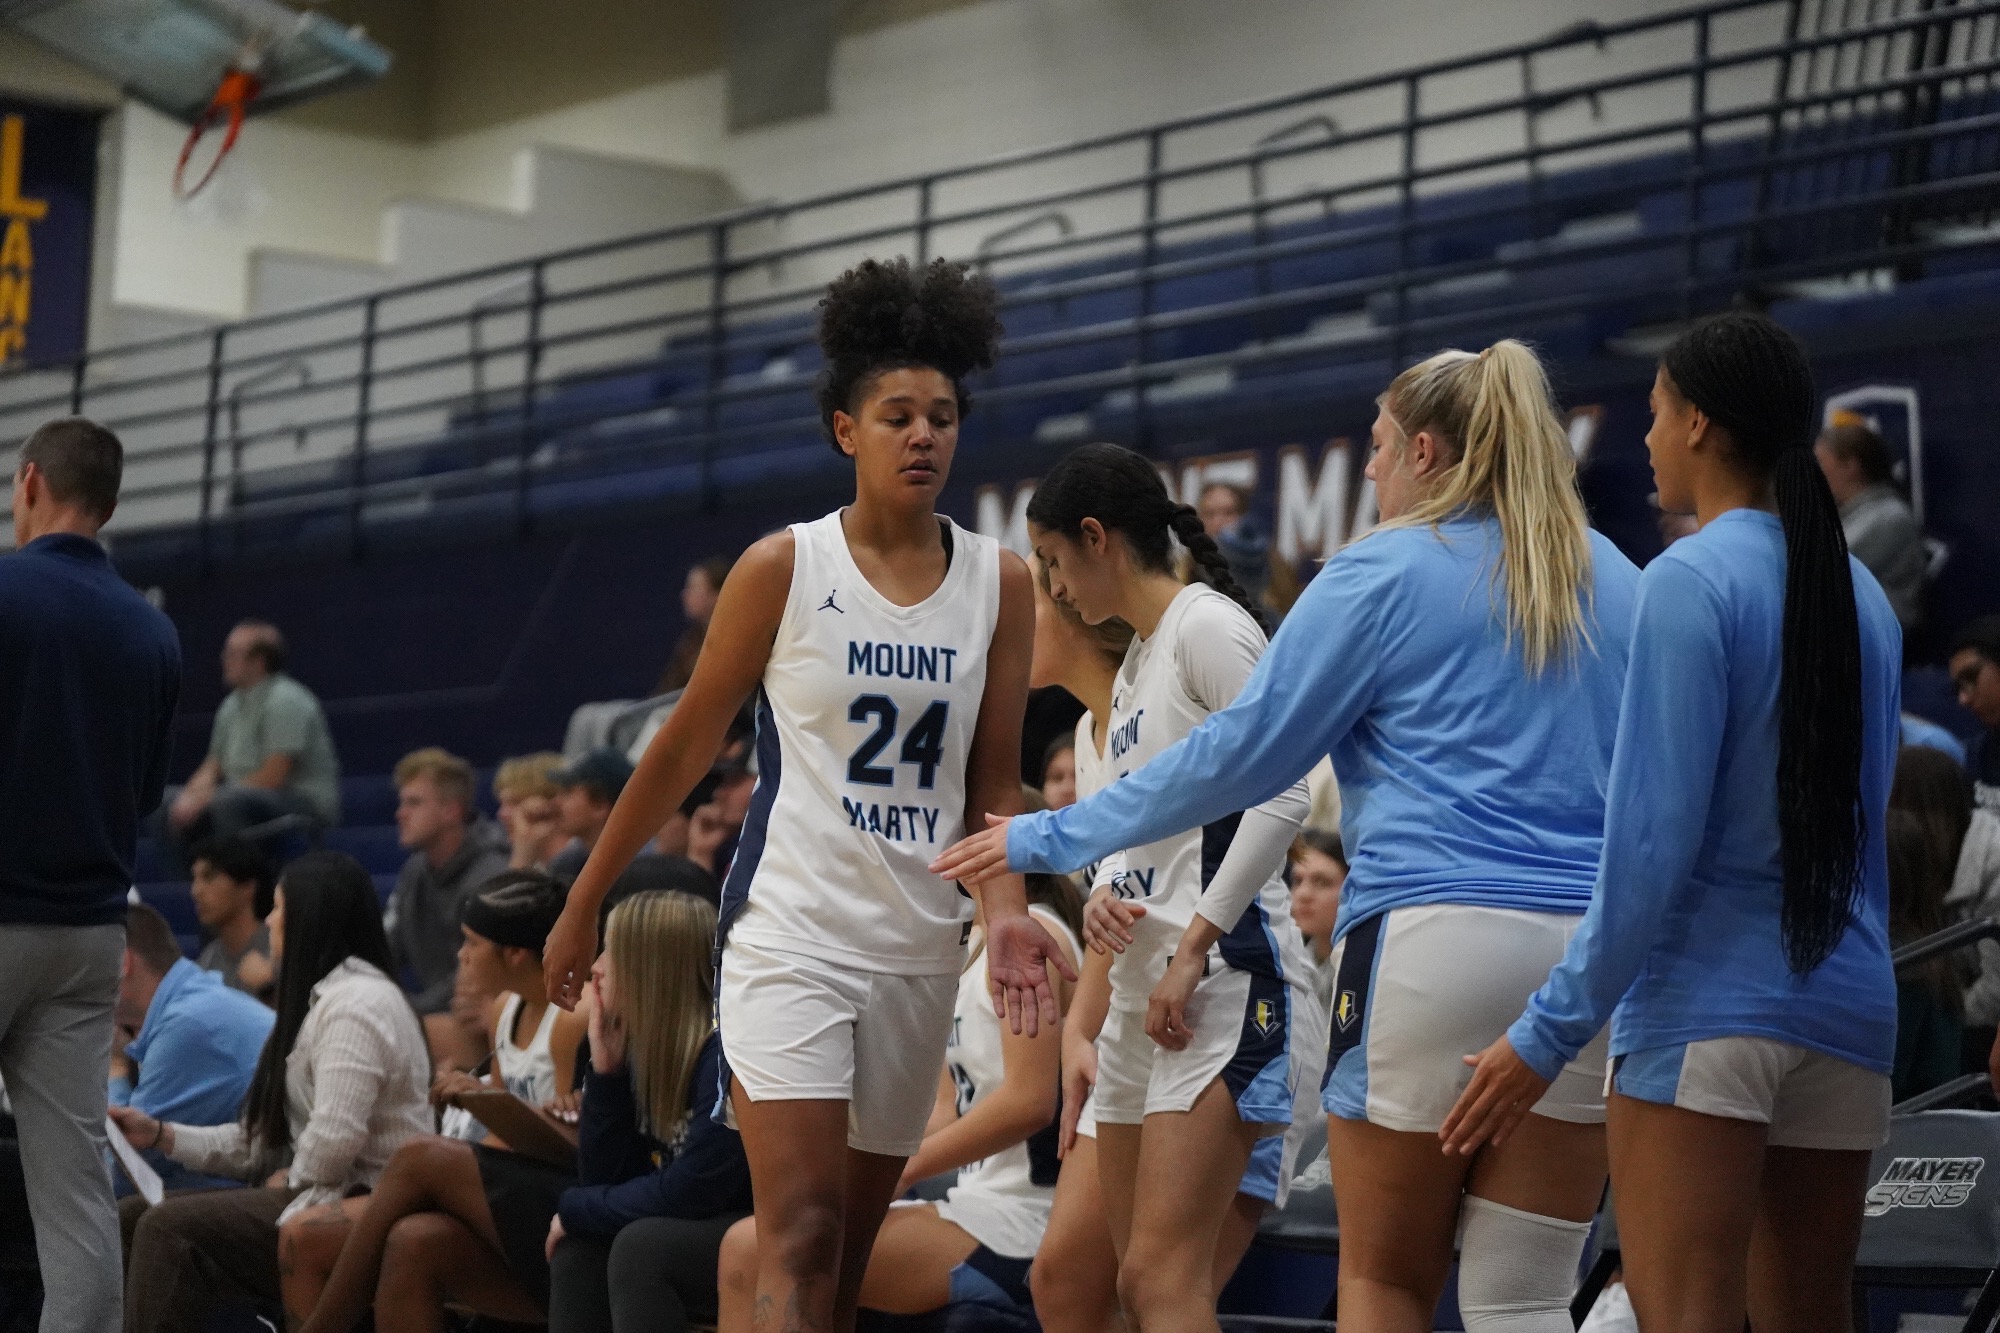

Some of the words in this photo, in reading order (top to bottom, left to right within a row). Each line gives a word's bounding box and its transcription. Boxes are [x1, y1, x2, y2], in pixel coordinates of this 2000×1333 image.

[847, 641, 957, 683] MOUNT
[846, 693, 949, 790] 24
[842, 796, 939, 843] MARTY
[1880, 1158, 1984, 1182] MAYER
[1864, 1184, 1971, 1215] SIGNS
